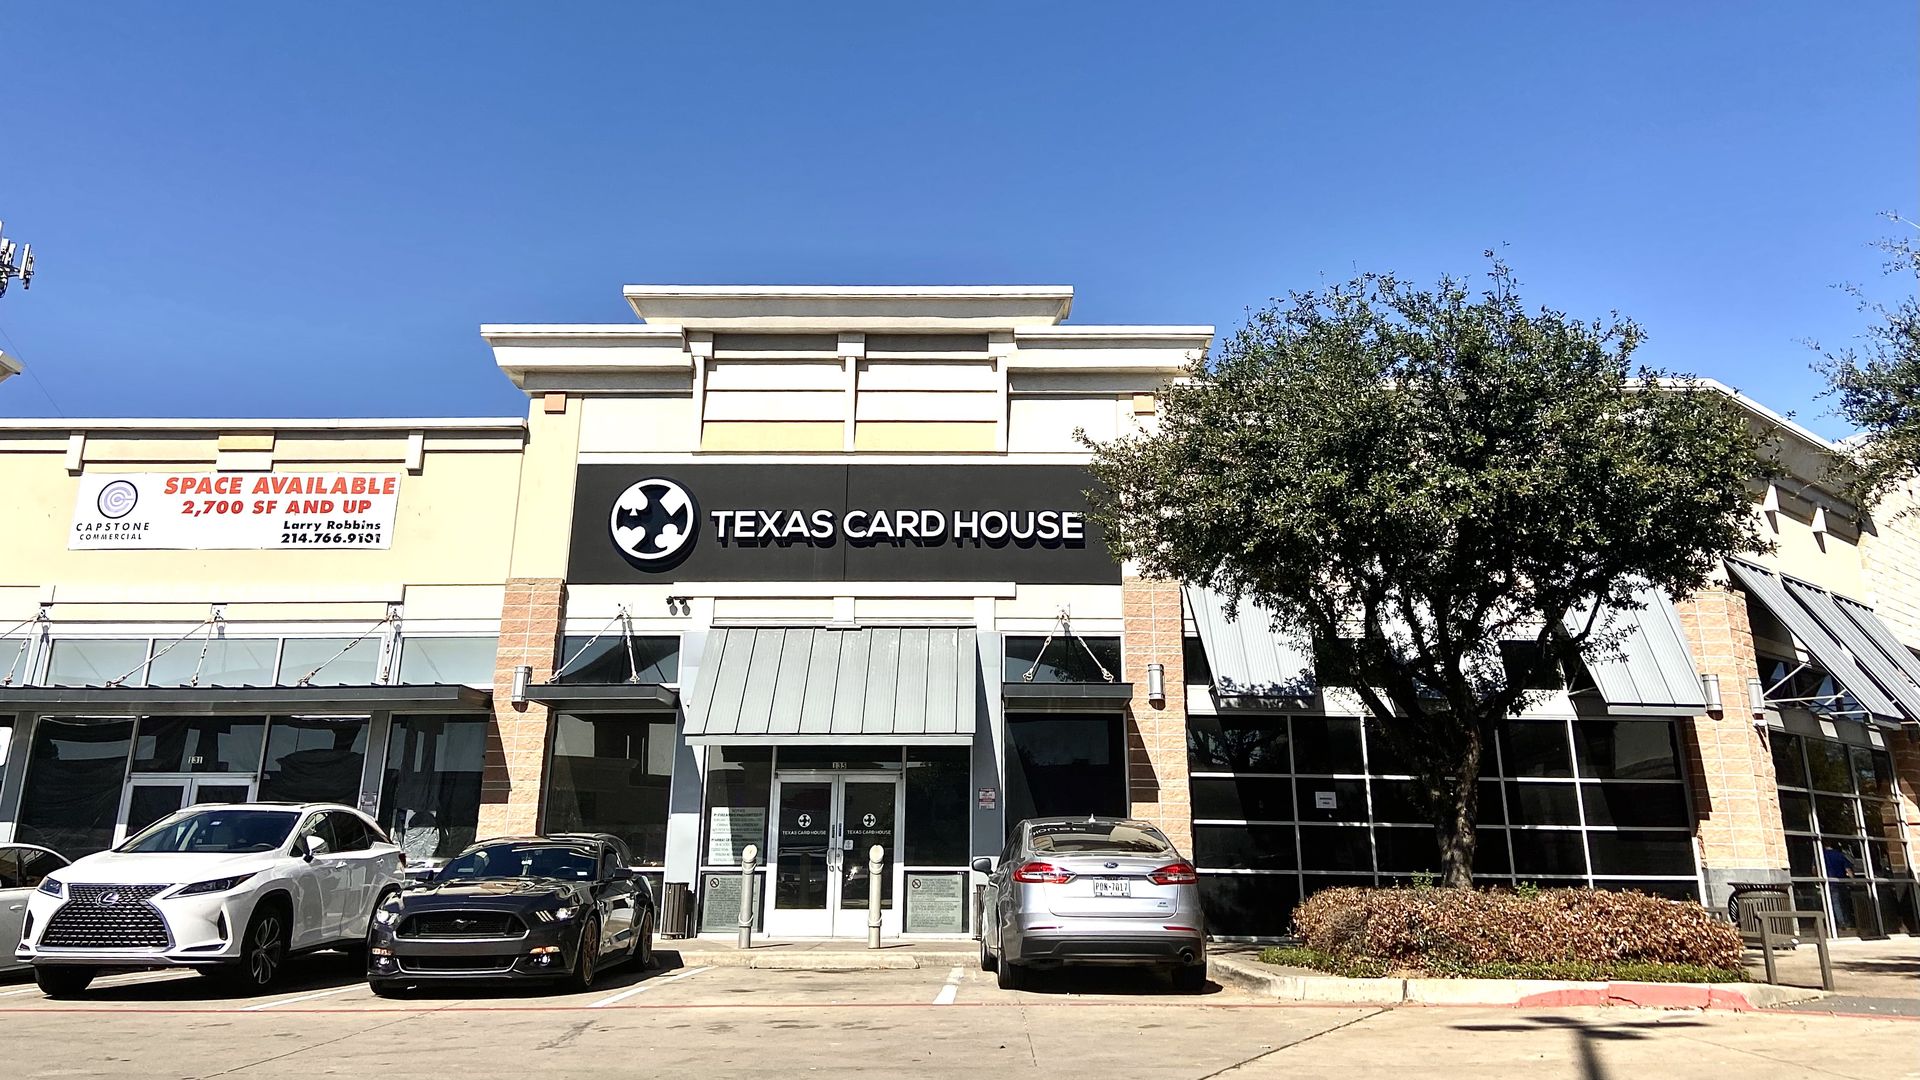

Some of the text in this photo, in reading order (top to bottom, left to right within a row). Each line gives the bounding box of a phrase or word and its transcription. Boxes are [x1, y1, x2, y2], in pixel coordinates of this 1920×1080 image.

[164, 477, 396, 495] SPACE AVAILABLE
[181, 500, 372, 517] 2,700 SF AND UP
[76, 522, 150, 531] CAPSTONE
[283, 520, 381, 532] Larry Robbins
[711, 510, 1084, 539] TEXAS CARD HOUSE
[281, 533, 381, 543] 214.766.9101
